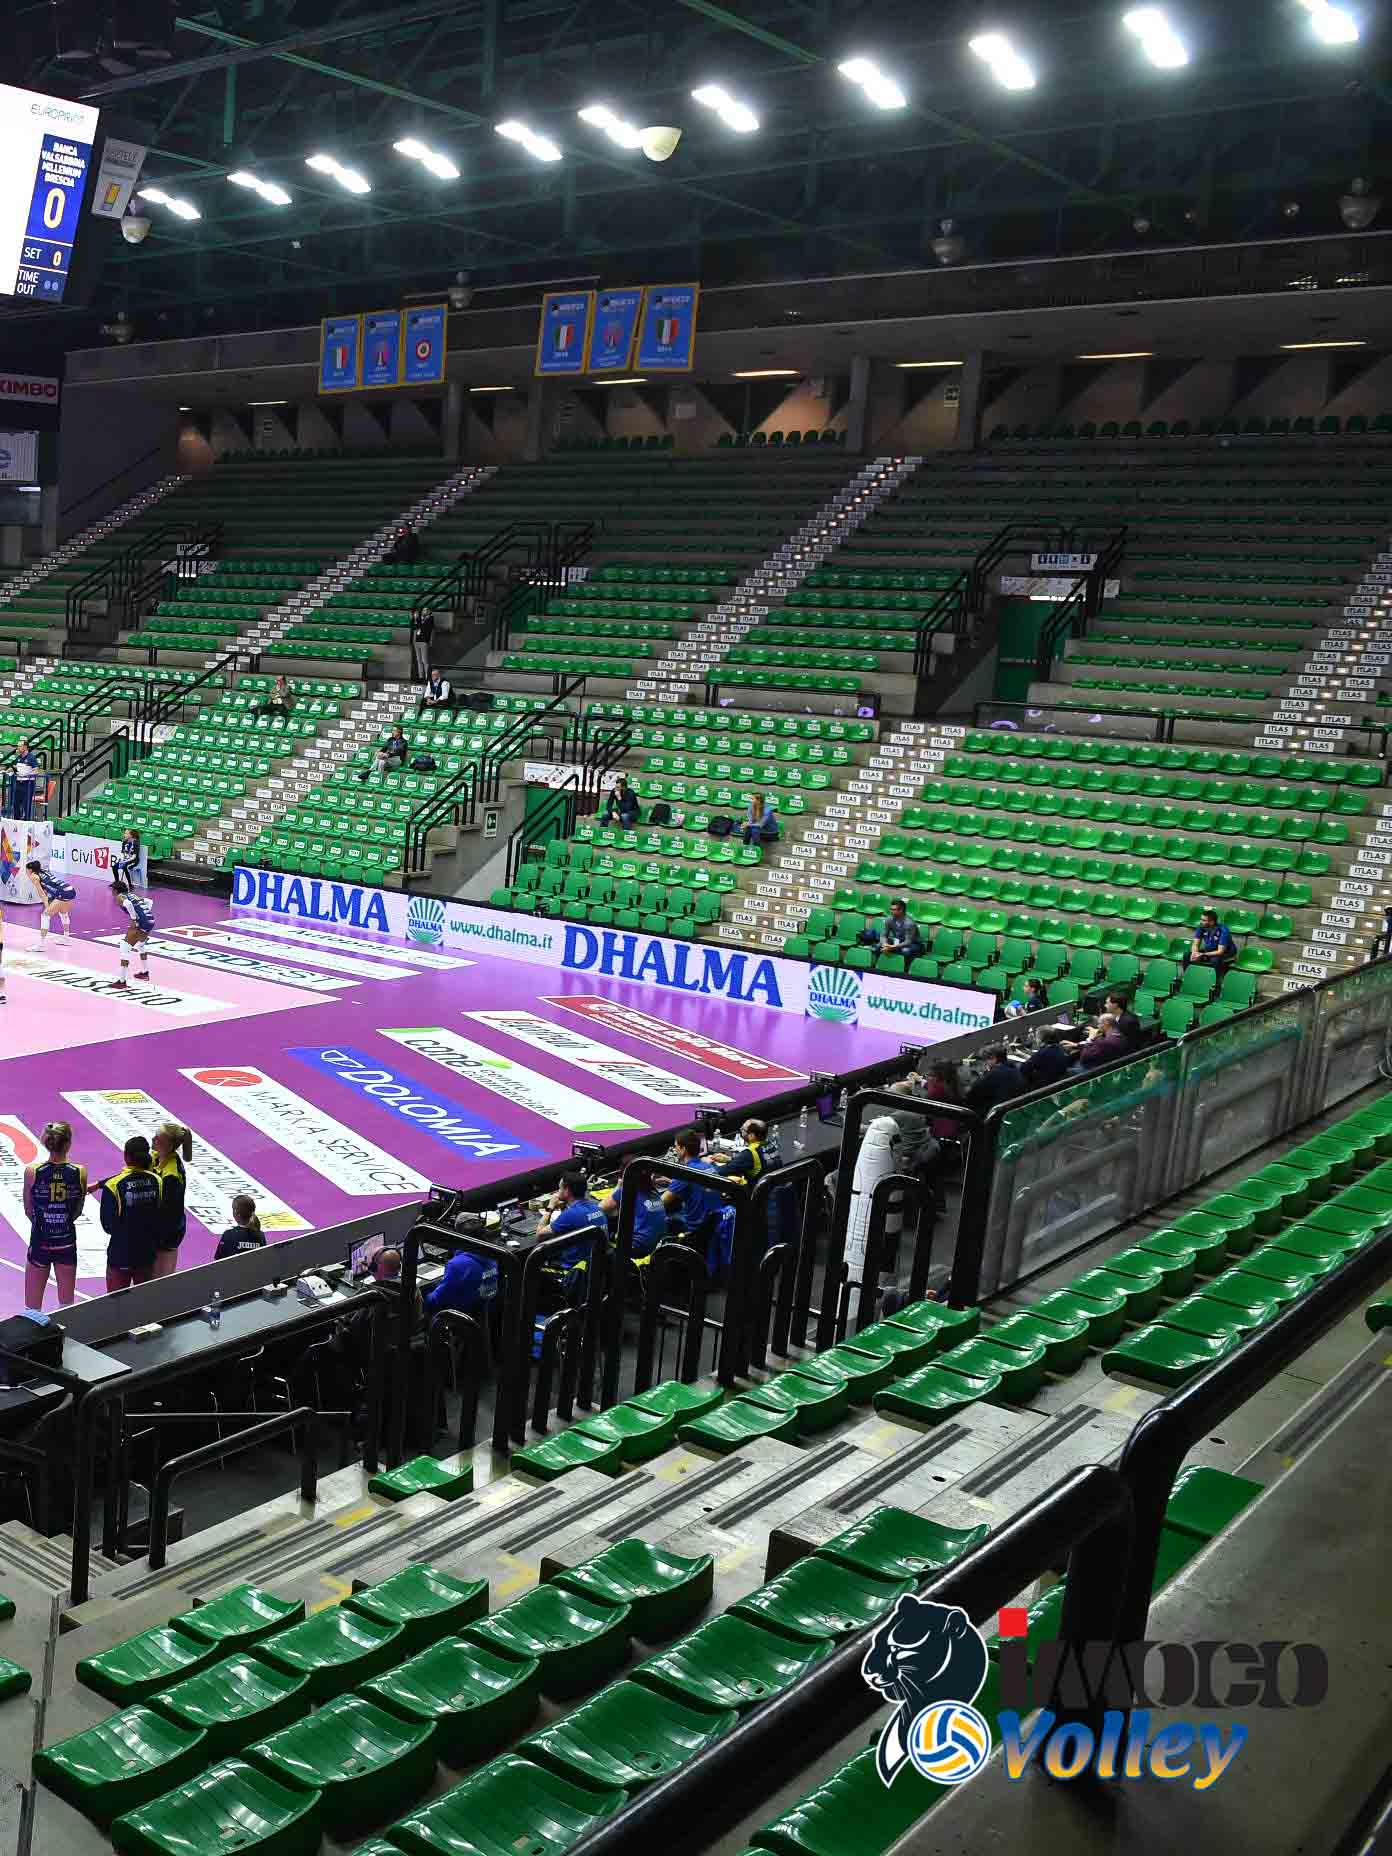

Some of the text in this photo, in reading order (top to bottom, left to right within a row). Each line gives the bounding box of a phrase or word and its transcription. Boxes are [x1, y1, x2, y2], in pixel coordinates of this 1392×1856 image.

[43, 188, 66, 229] 0
[24, 246, 62, 266] SET 0
[18, 269, 40, 284] TIME
[16, 283, 36, 296] OUT
[71, 848, 94, 864] Civi
[1355, 867, 1378, 875] ITLAS
[1345, 883, 1368, 891] ITLAS
[232, 867, 390, 933] DHALMA
[1336, 899, 1359, 907] ITLAS
[408, 917, 443, 933] DHALMA
[1327, 915, 1350, 924] ITLAS
[450, 918, 553, 951] www.dhalma.it
[1317, 931, 1341, 940] ITLAS
[1308, 948, 1332, 956] ITLAS
[561, 924, 784, 1008] DHALMA
[1298, 964, 1322, 974] ITLAS
[27, 968, 184, 1007] MASCHIO
[809, 990, 857, 1009] DHALMA
[337, 1070, 521, 1157] DOLOMIA
[248, 1090, 329, 1136] MARKA
[317, 1138, 421, 1192] SERVICE
[50, 1183, 67, 1202] 15
